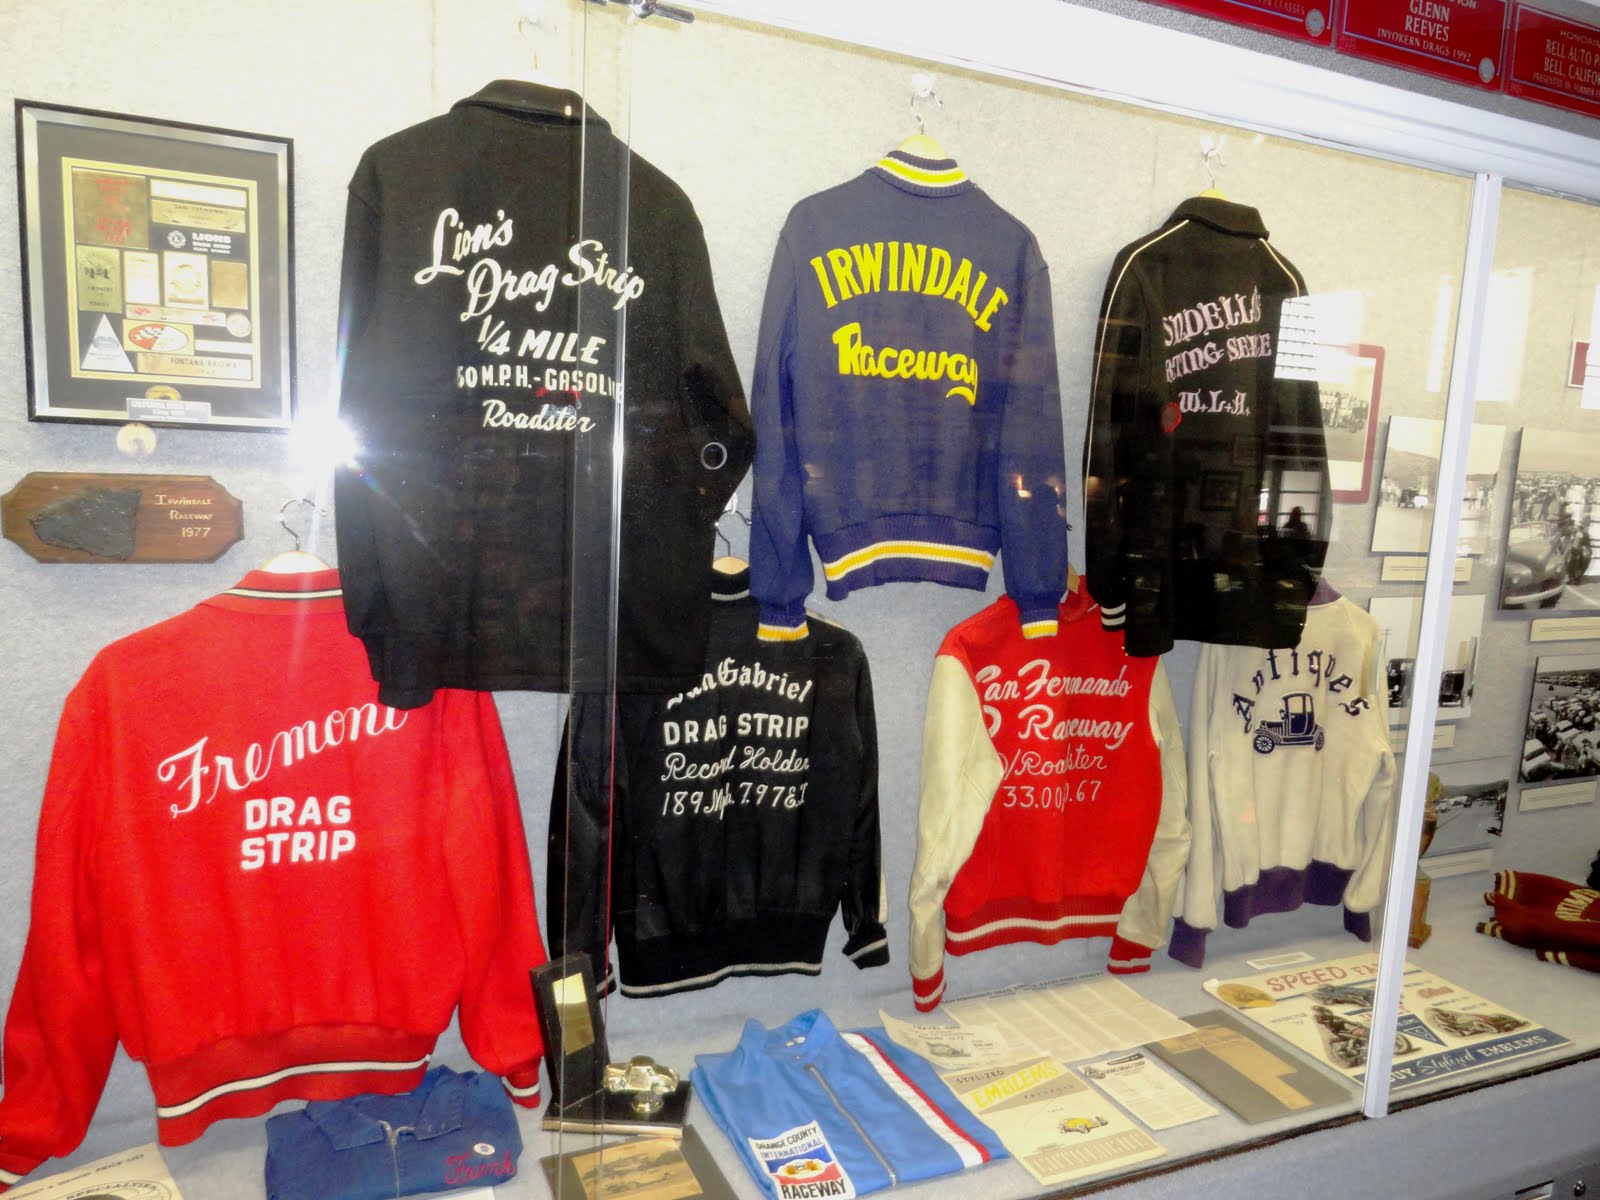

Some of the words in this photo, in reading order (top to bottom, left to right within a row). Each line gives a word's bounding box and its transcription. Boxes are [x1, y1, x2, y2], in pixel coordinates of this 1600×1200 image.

[1405, 14, 1449, 42] REEVES
[1409, 0, 1450, 23] GLENN
[1377, 28, 1421, 47] INYOKERN
[1423, 40, 1450, 56] DRAGS
[1545, 39, 1565, 59] BELL
[1568, 46, 1592, 65] AUTO
[414, 208, 513, 285] Lion's
[460, 257, 560, 322] Drag
[562, 239, 645, 311] Strip
[810, 241, 1009, 333] IRWINDALE
[517, 329, 607, 364] MILE
[832, 322, 978, 406] Raceway
[482, 399, 596, 433] Roadster
[182, 527, 211, 537] 1977
[717, 656, 813, 702] Gabriel
[1017, 658, 1132, 700] Fernando
[1232, 648, 1370, 734] Antiques
[663, 714, 727, 745] DRAG
[737, 713, 809, 738] STRIP
[245, 795, 352, 831] DRAG
[240, 829, 356, 871] STRIP
[1266, 966, 1348, 992] SPEED
[1477, 1035, 1548, 1057] EMBLEMS
[970, 1057, 1059, 1110] EMBLEMS
[760, 1137, 824, 1159] INTERNATIONAL
[786, 1126, 818, 1145] COUNTY
[780, 1178, 847, 1200] RACEWAY
